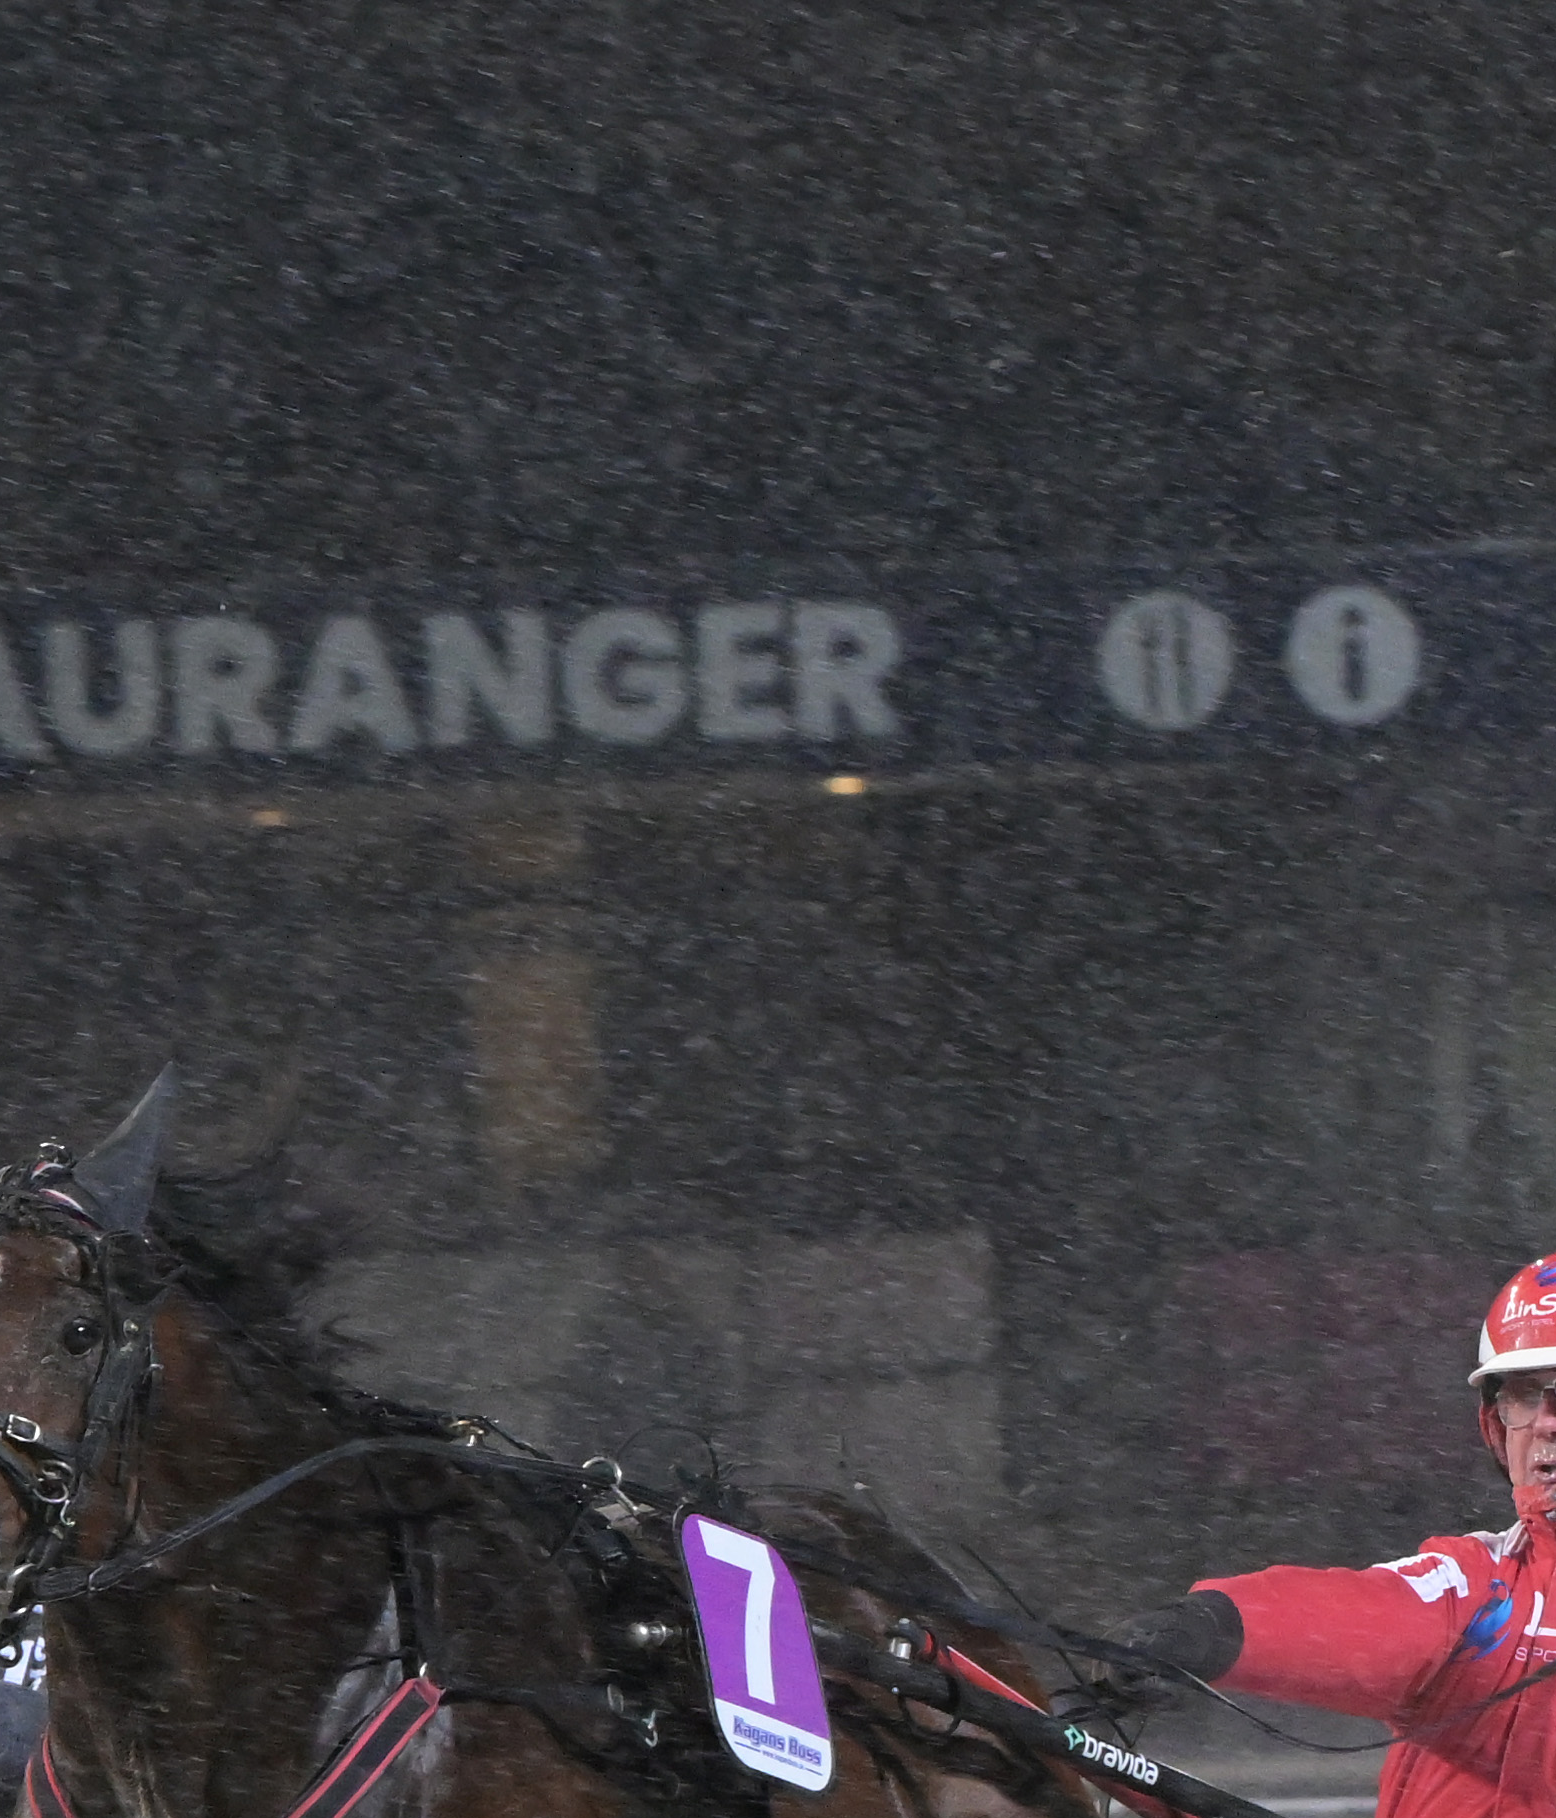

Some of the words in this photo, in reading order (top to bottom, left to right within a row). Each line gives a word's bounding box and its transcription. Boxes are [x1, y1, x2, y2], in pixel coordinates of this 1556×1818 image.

[698, 1520, 776, 1705] 7
[732, 1714, 786, 1752] Kagans
[788, 1734, 822, 1767] Buss
[1082, 1729, 1159, 1786] bravida
